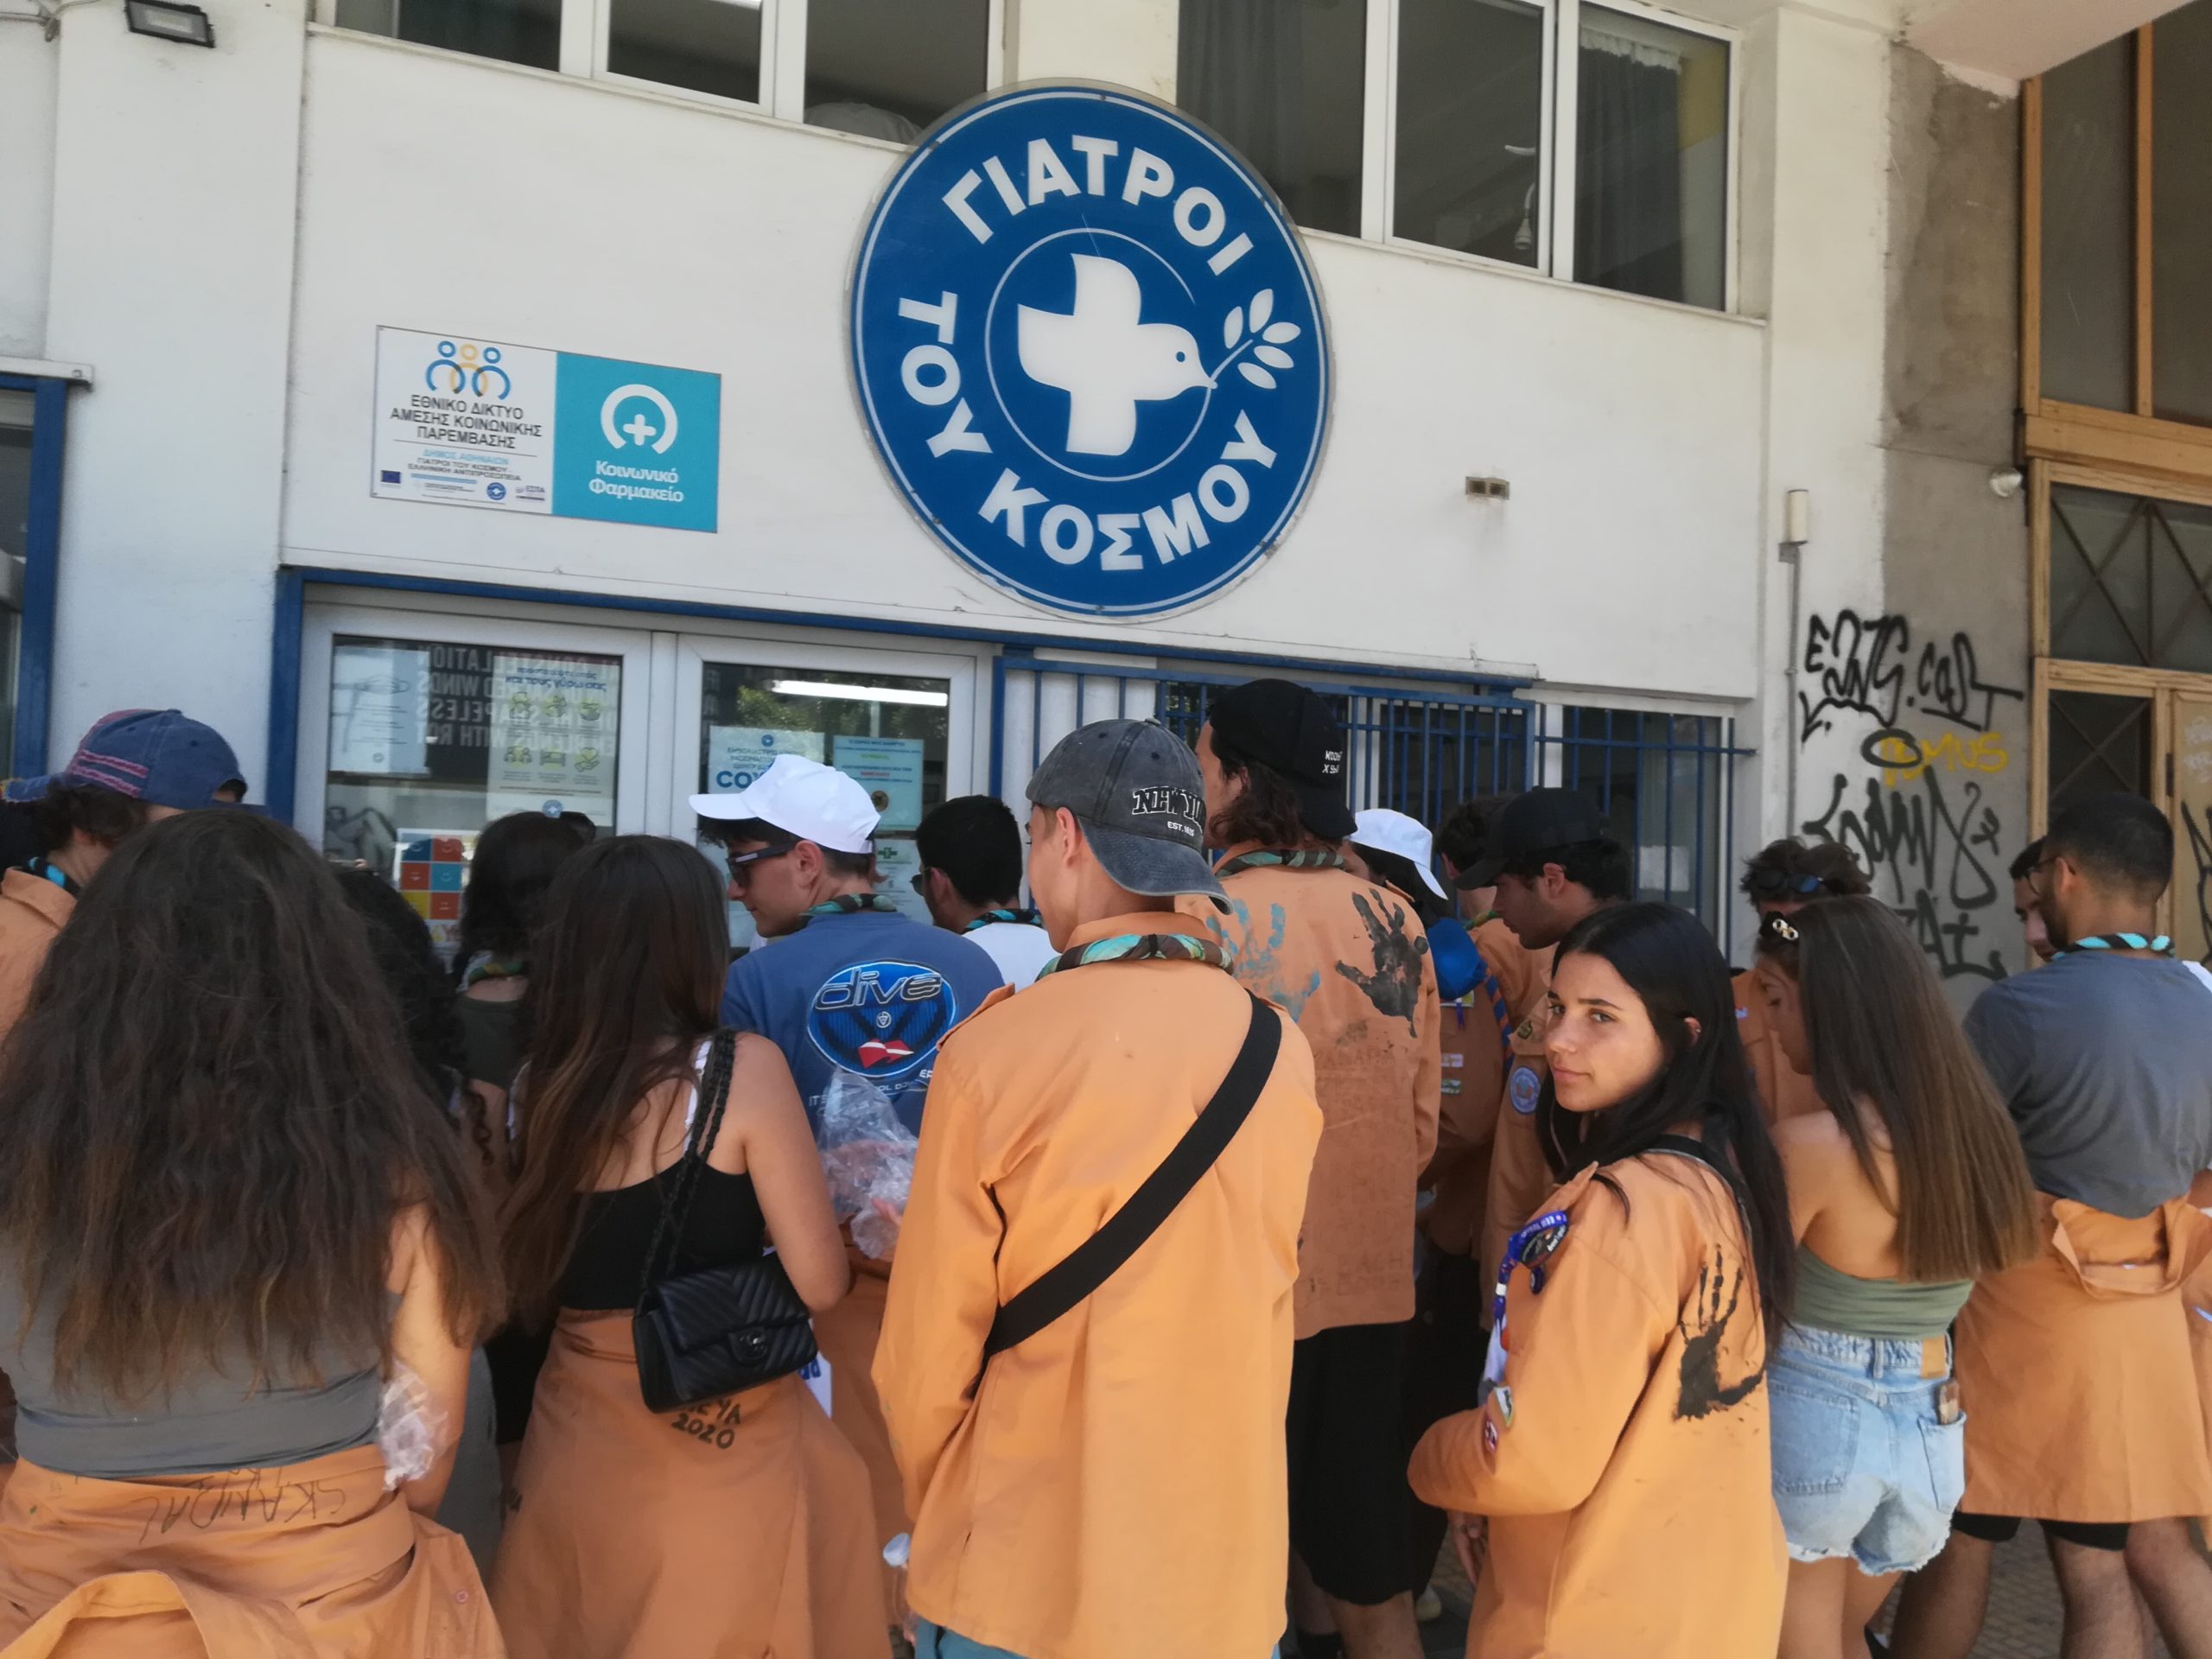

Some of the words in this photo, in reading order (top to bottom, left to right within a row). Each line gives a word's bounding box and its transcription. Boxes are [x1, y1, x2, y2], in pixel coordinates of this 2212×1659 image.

[942, 134, 1254, 276] ΓΙΑΤΡΟΙ
[411, 394, 467, 412] ΕΘΝΙΚΟ
[471, 403, 524, 420] ΔΙΚΤΥΟ
[391, 408, 449, 426] ΑΜΕΣΗΣ
[454, 416, 542, 437] ΚΟΙΝΩΝΙΚΗΣ
[899, 290, 993, 458] ΤΟΥ
[978, 409, 1277, 571] ΚΟΣΜΟΥ
[417, 426, 516, 449] ΠΑΡΕΜΒΑΣΗΣ
[595, 460, 678, 484] Κοινωνικό
[588, 477, 684, 503] Φαρμακείο
[815, 967, 942, 1010] dive
[671, 1413, 735, 1450] 2020
